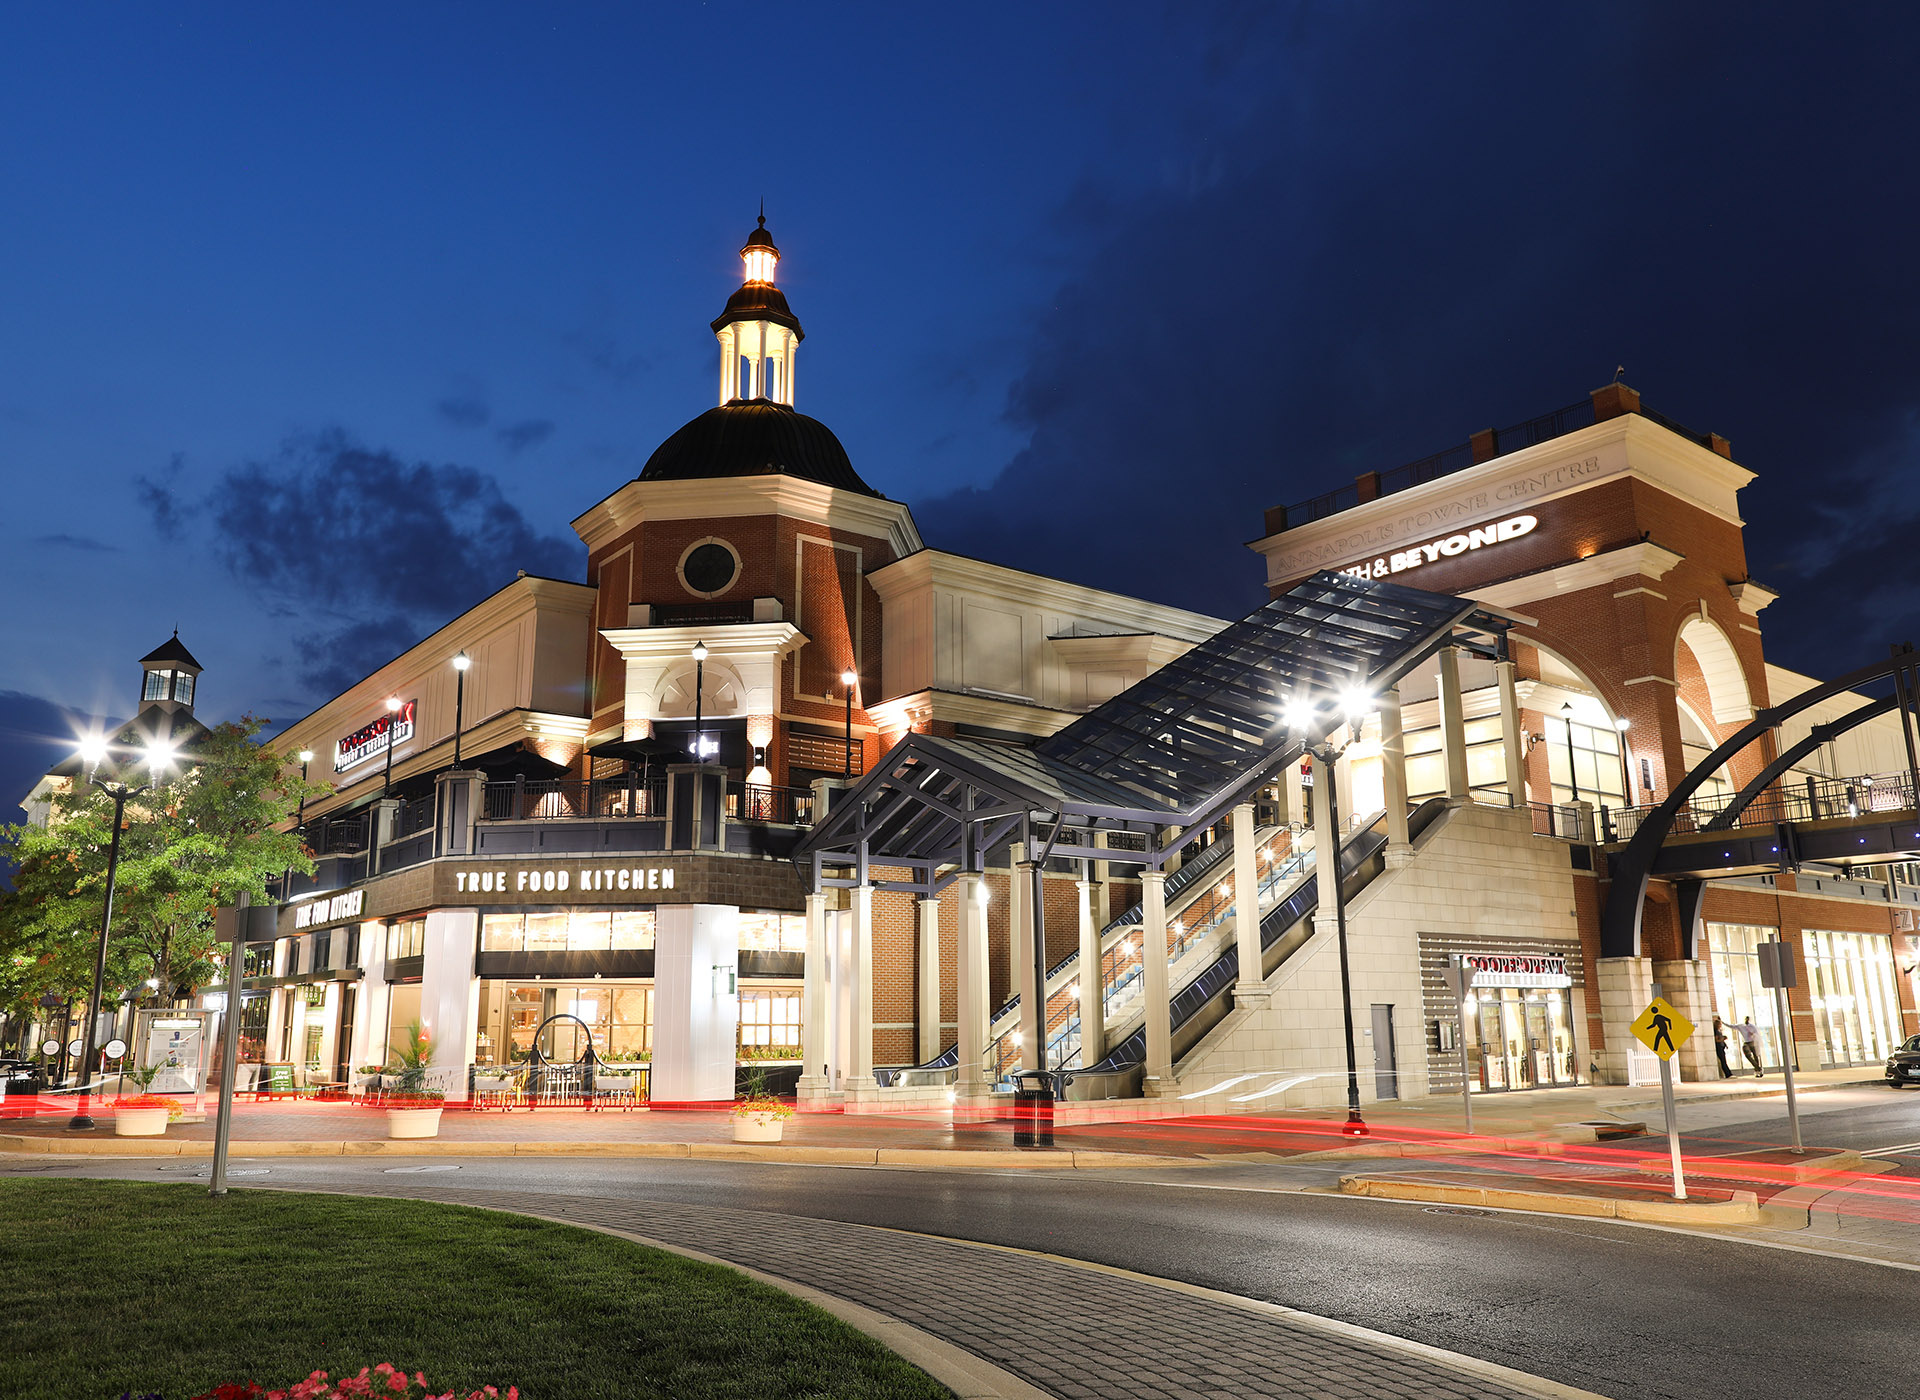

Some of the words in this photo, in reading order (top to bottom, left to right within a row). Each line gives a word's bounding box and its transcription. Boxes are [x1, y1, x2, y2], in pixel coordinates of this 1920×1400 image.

[1276, 523, 1394, 573] ANNAPOLIS
[1399, 493, 1489, 533] TOWNE
[1495, 456, 1601, 501] CENTRE
[1372, 558, 1390, 578] &
[1390, 515, 1538, 573] BEYOND
[456, 871, 507, 892] TRUE
[517, 870, 570, 892] FOOD
[580, 868, 675, 891] KITCHEN
